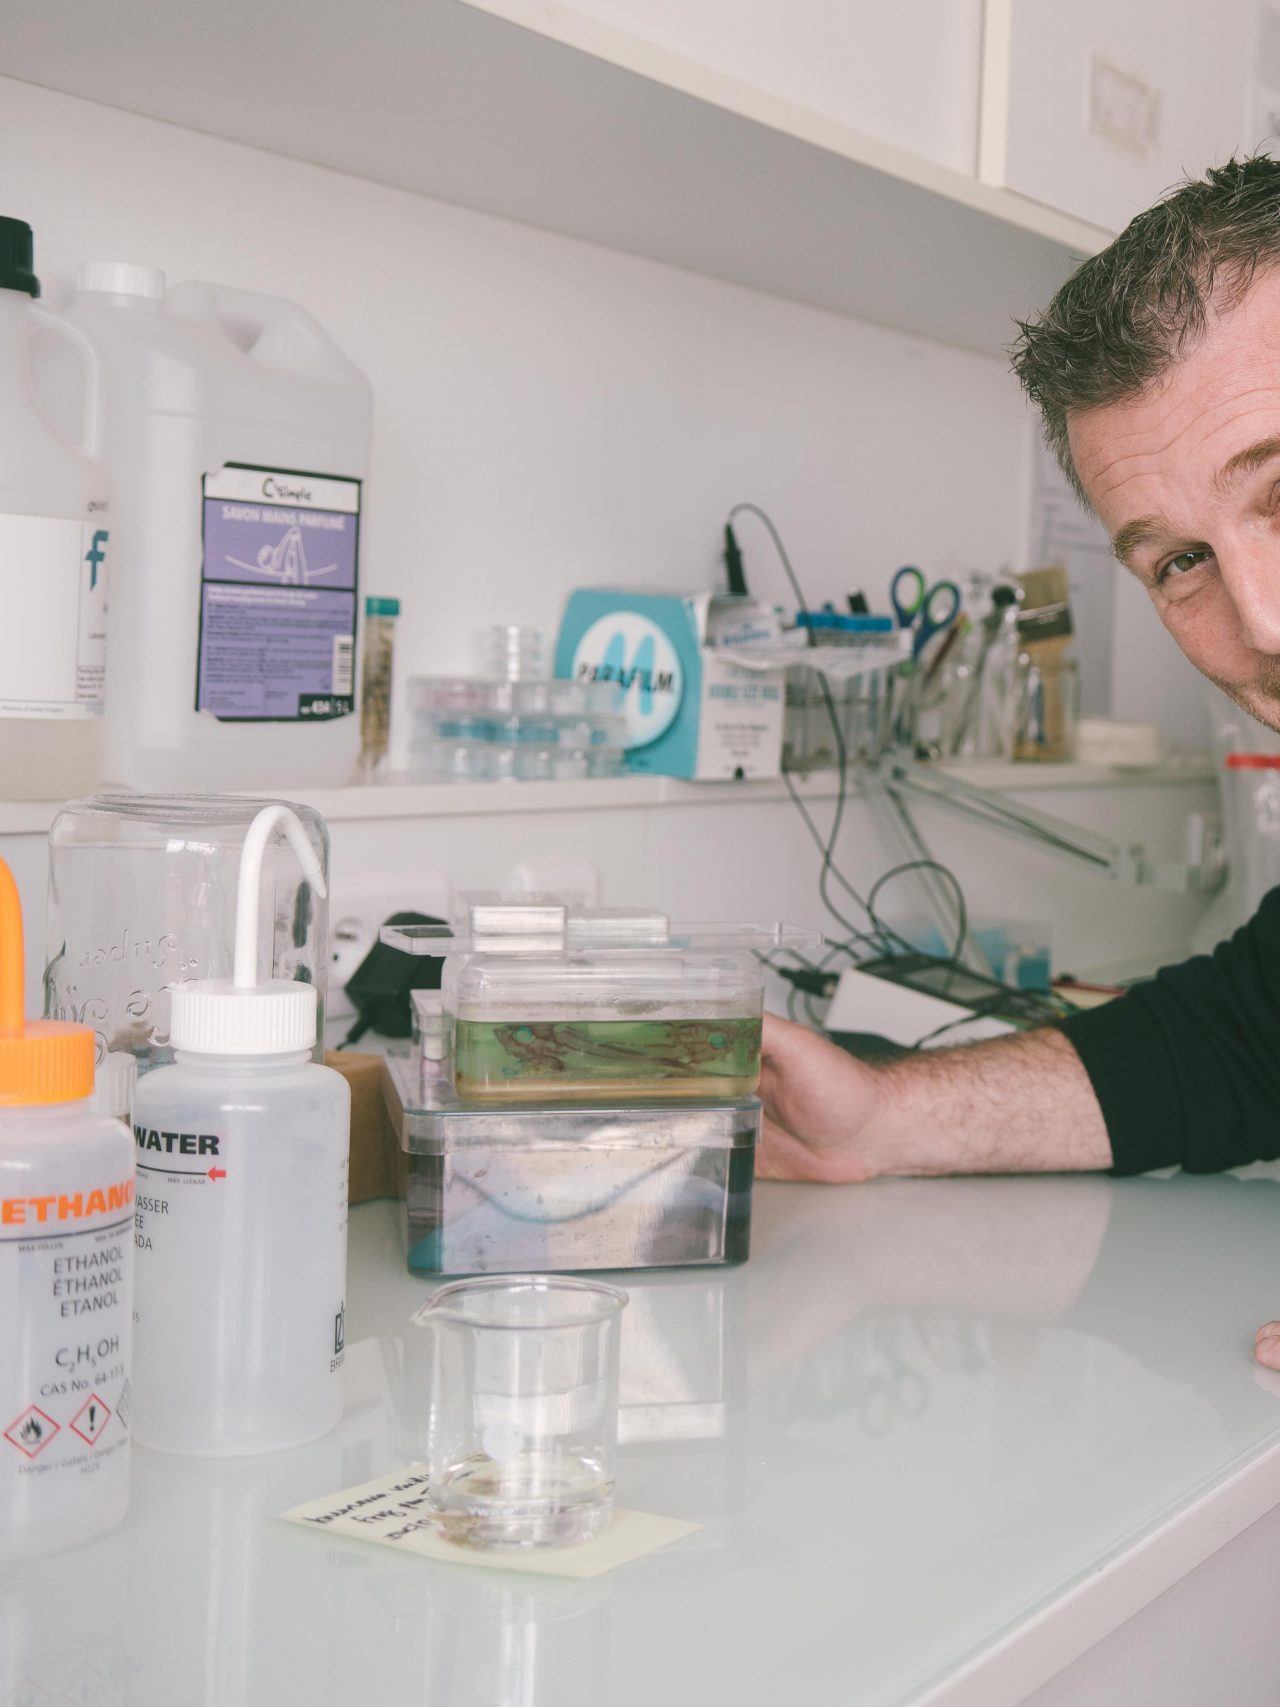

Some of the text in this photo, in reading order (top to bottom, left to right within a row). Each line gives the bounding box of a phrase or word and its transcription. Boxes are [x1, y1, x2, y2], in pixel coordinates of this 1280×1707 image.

[222, 505, 260, 523] SAVON
[133, 1124, 220, 1156] WATER
[53, 1246, 123, 1275] ETHANOL
[60, 1290, 119, 1318] ETANOL
[40, 1382, 67, 1397] CAS
[71, 1378, 90, 1392] No.
[18, 1463, 52, 1475] Danger
